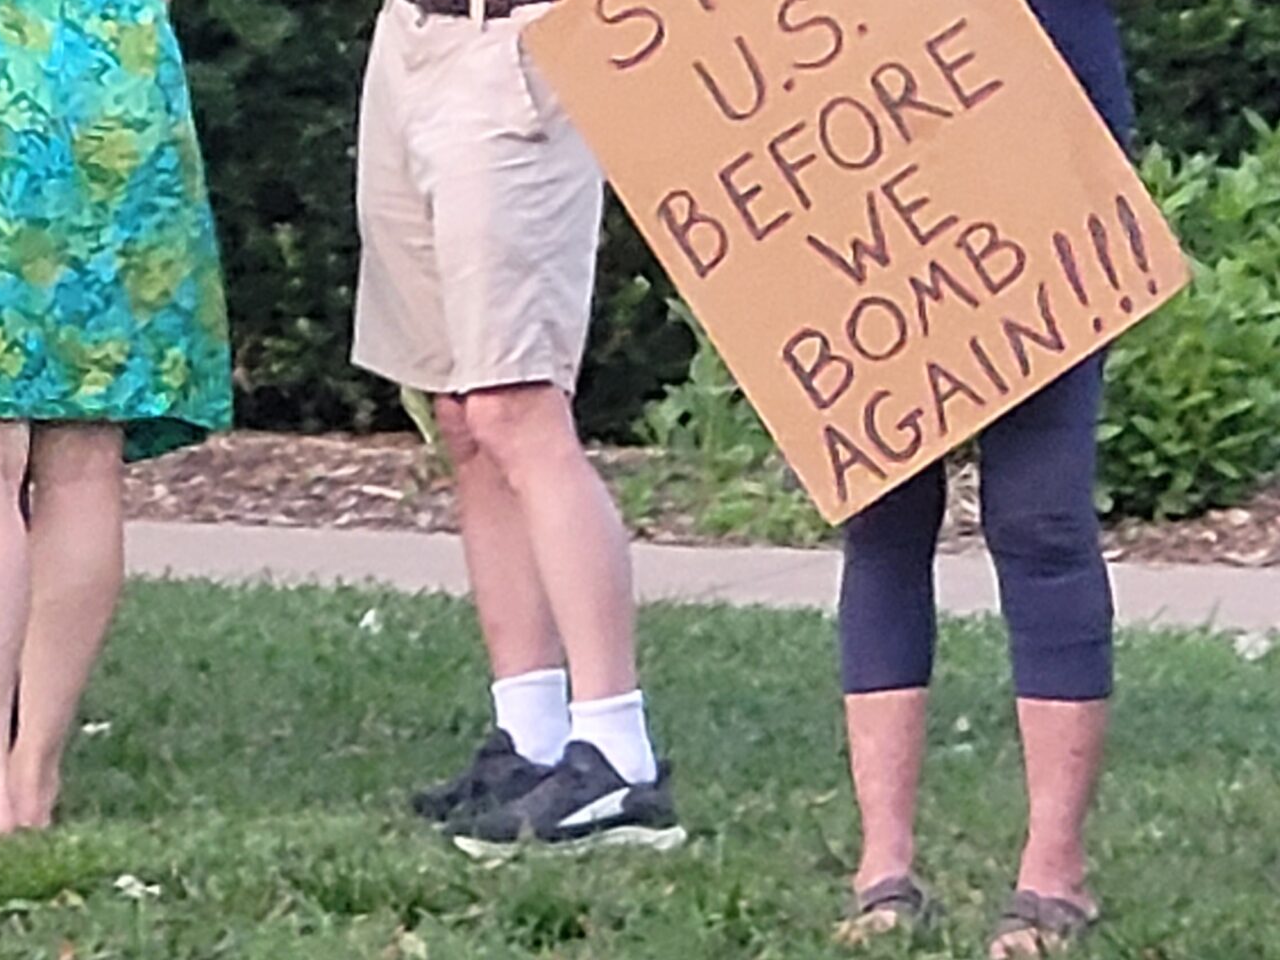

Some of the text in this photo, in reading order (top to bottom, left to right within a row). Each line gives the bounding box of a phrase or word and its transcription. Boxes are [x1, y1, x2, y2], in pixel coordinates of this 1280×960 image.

[656, 17, 1004, 279] BEFORE
[806, 163, 960, 286] WE
[781, 220, 1028, 410] BOMB
[818, 195, 1160, 503] AGAIN!!!
